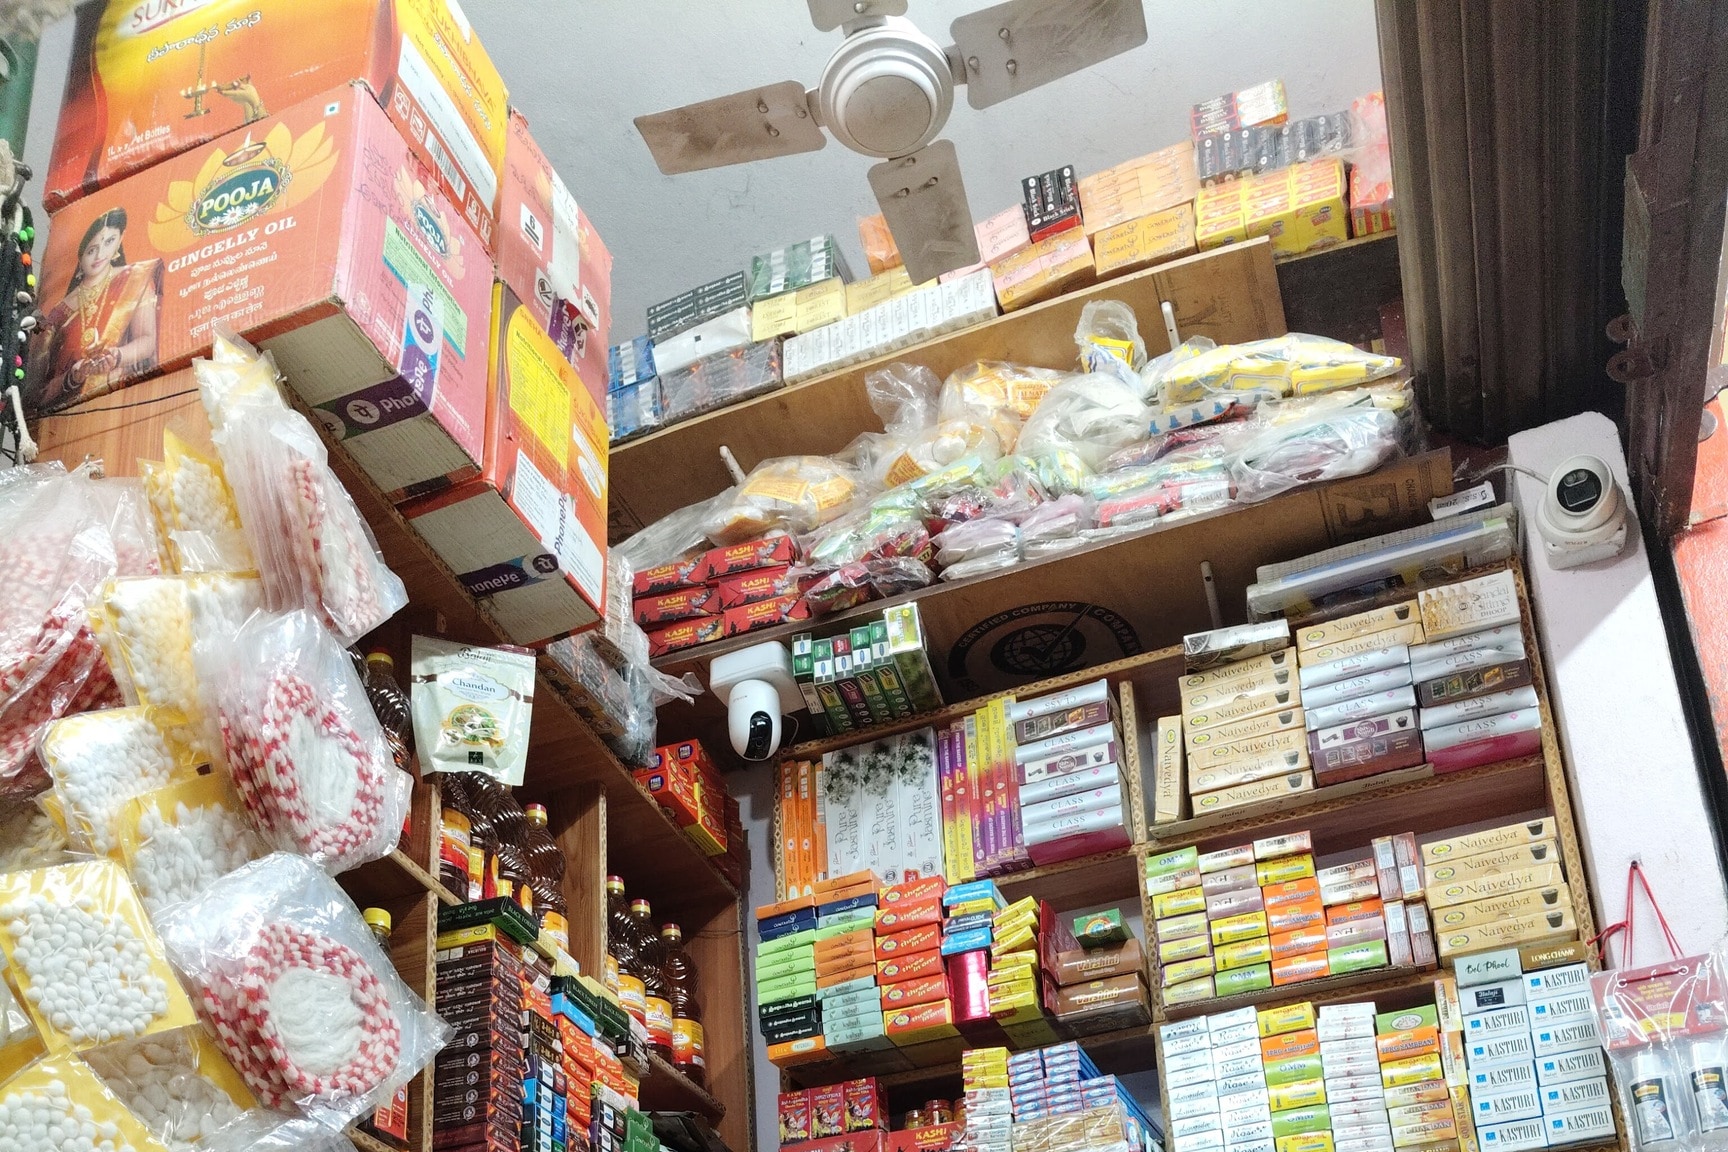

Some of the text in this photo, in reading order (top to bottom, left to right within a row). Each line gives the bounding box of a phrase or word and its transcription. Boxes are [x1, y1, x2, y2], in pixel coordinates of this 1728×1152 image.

[200, 177, 274, 219] POOJA
[1043, 212, 1059, 222] Black
[168, 216, 297, 273] GINGELLY OIL
[725, 545, 754, 557] KASHI
[647, 565, 675, 576] KASHI
[742, 577, 770, 588] KASHI
[658, 595, 687, 606] KASHI
[748, 601, 776, 614] KASHI
[959, 602, 1077, 648] CERTIFIED COMPANY
[1333, 613, 1385, 632] Naivedya
[665, 626, 693, 638] KASHI
[1336, 633, 1397, 656] Naivedya
[1443, 633, 1481, 648] CLASS
[1332, 655, 1369, 669] CLASS
[1445, 650, 1483, 666] CLASS
[1211, 659, 1263, 681] Naivedya
[452, 678, 496, 693] Chandan
[1334, 677, 1371, 691] CLASS
[1215, 699, 1268, 720] Naivedya
[1218, 719, 1270, 739] Naivedya
[1458, 719, 1497, 734] CLASS
[1044, 735, 1077, 748] CLASS
[1231, 734, 1291, 756] Naivedya
[1163, 745, 1176, 798] Naivedya
[1048, 775, 1081, 788] CLASS
[1226, 782, 1280, 802] Naivedya
[909, 794, 922, 827] Pure
[1051, 797, 1084, 810] CLASS
[872, 802, 885, 835] Pure
[1052, 816, 1085, 829] CLASS
[835, 812, 849, 844] Pure
[1460, 829, 1518, 850] Naivedya
[1463, 851, 1519, 871] Naivedya
[904, 883, 926, 899] three
[925, 882, 939, 894] one
[1466, 872, 1533, 895] Naivedya
[920, 905, 935, 917] one
[1474, 895, 1531, 915] Naivedya
[900, 906, 922, 921] three
[921, 931, 935, 942] one
[1478, 919, 1535, 939] Naivedya
[900, 932, 923, 948] three
[922, 956, 937, 968] one
[1531, 948, 1576, 962] LONG CHAMP
[902, 957, 925, 973] three
[1465, 958, 1510, 974] Bel Phool
[1544, 968, 1586, 985] KASTURI
[907, 982, 929, 997] three
[926, 981, 942, 993] one
[1549, 996, 1591, 1013] KASTURI
[912, 1008, 932, 1022] three
[930, 1007, 945, 1019] one
[1484, 1010, 1526, 1031] KASTURI
[1554, 1023, 1597, 1043] KASTURI
[1487, 1037, 1529, 1058] KASTURI
[1558, 1052, 1601, 1073] KASTURI
[1490, 1065, 1532, 1085] KASTURI
[1562, 1081, 1605, 1102] KASTURI
[1494, 1093, 1536, 1113] KASTURI
[1567, 1110, 1610, 1131] KASTURI
[916, 1128, 947, 1140] KASHI
[1499, 1123, 1542, 1144] KASTURI
